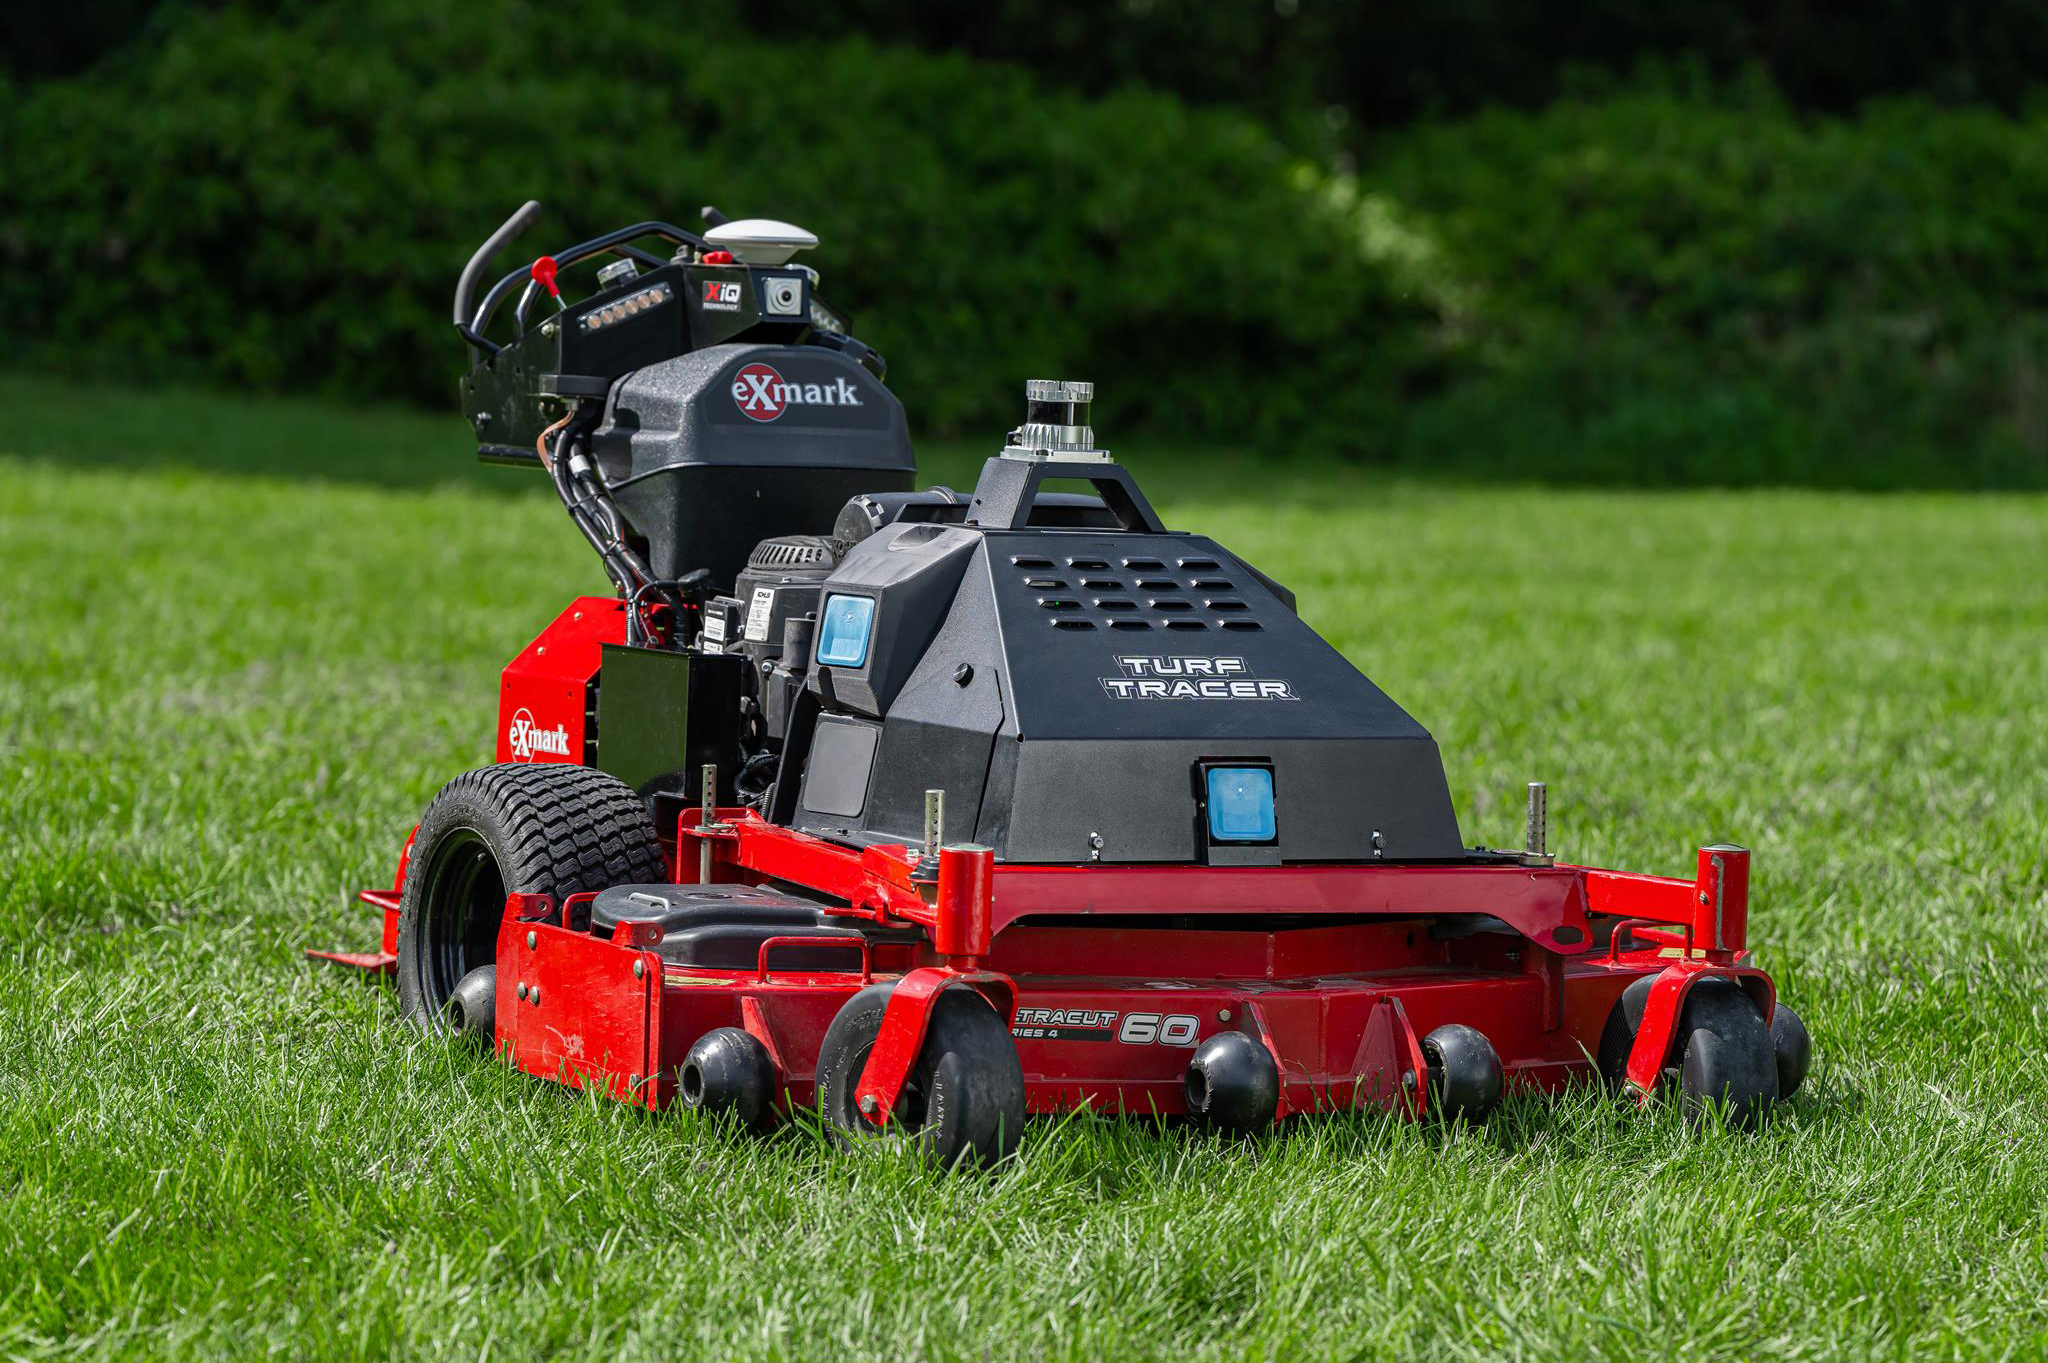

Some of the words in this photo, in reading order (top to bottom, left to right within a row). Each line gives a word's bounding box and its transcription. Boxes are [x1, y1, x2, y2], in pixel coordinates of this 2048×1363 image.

[703, 302, 739, 311] TECHNOLOGY
[732, 374, 860, 411] eXmark
[1121, 657, 1244, 675] TURF
[1105, 679, 1292, 698] TRACER
[510, 719, 570, 757] eXmark
[1011, 1028, 1044, 1038] RIES
[1048, 1029, 1058, 1038] 4
[1015, 1008, 1118, 1027] TRACUT
[1119, 1013, 1199, 1046] 60
